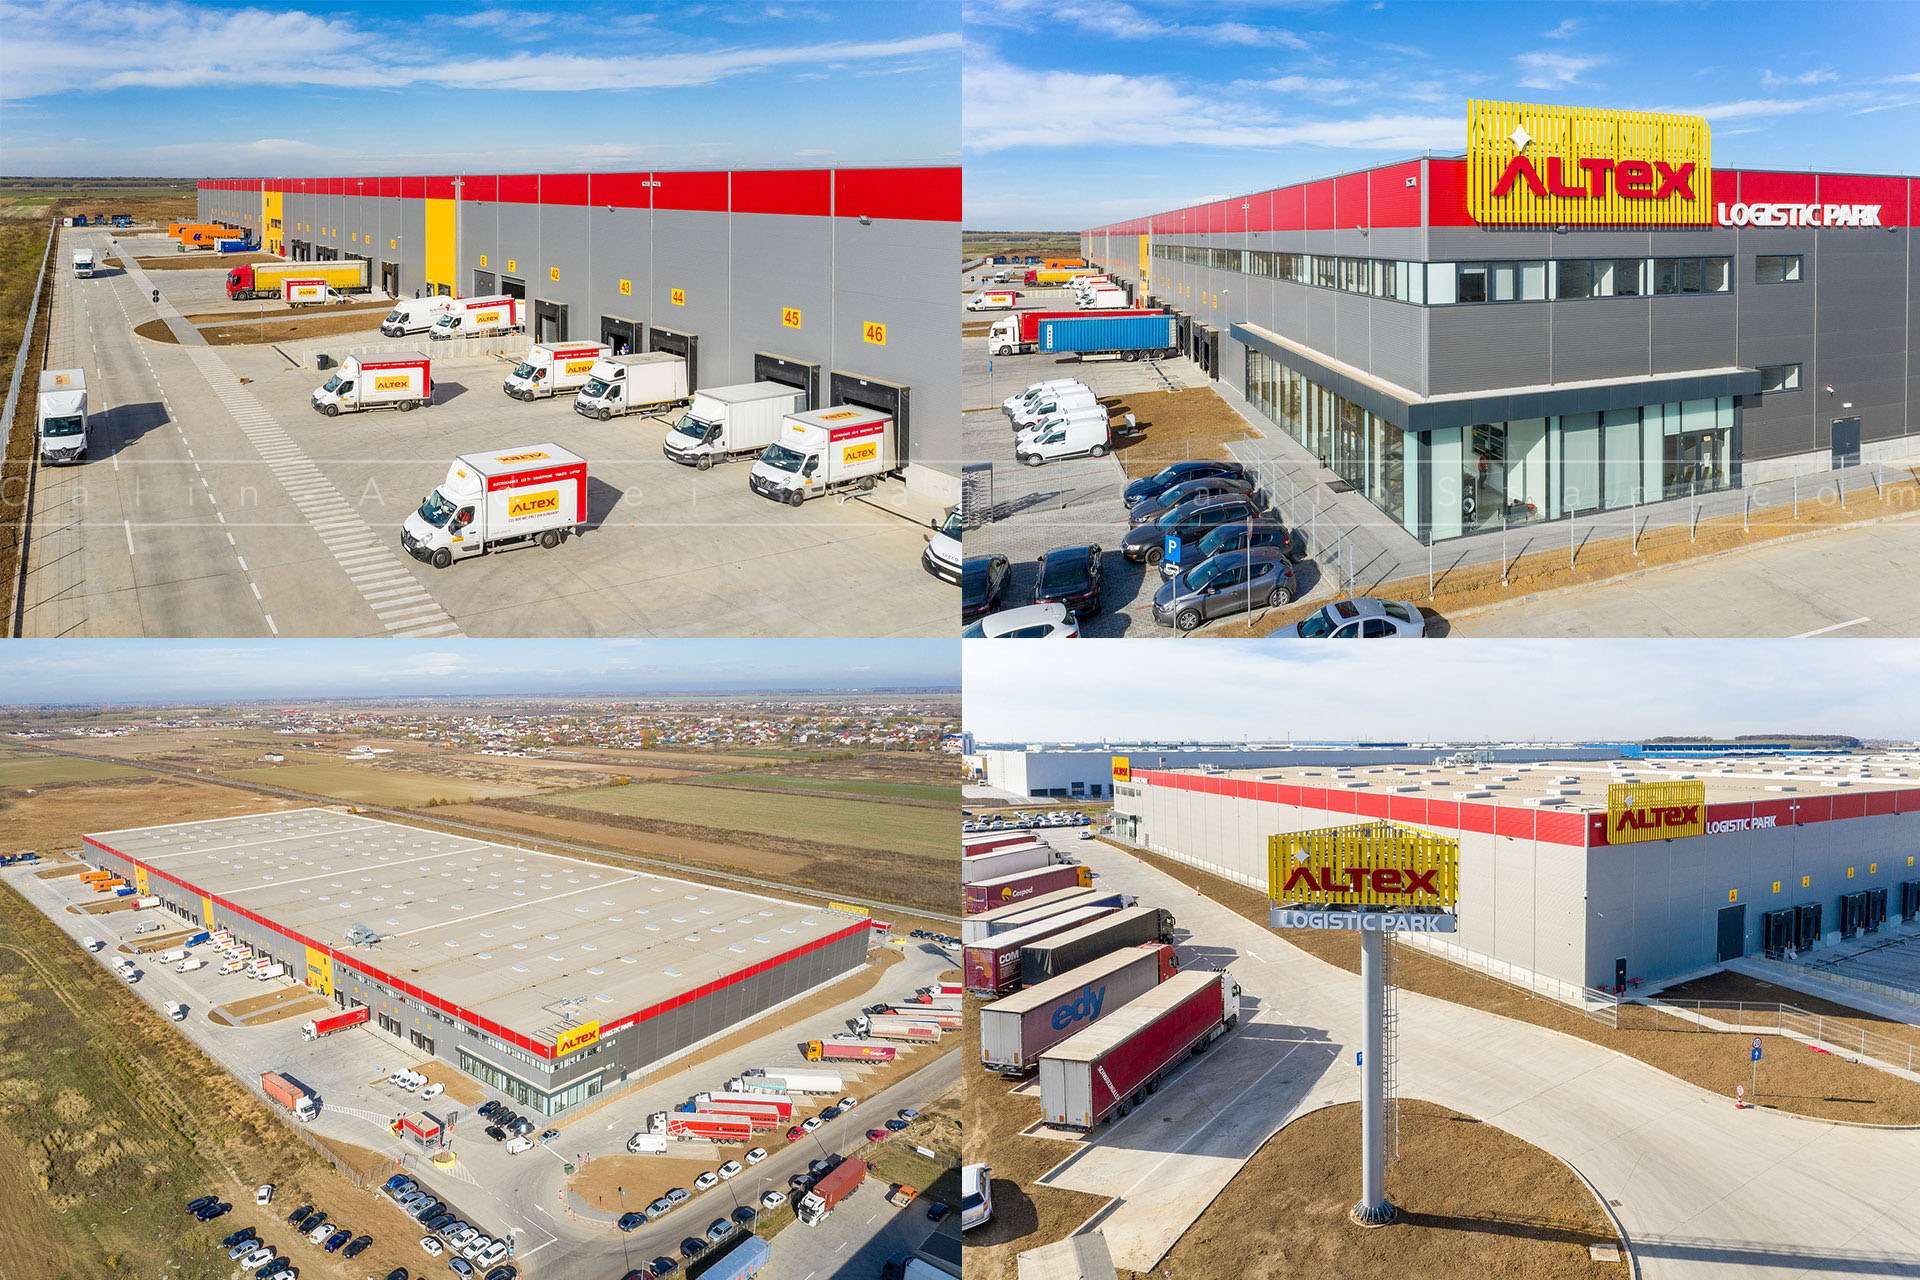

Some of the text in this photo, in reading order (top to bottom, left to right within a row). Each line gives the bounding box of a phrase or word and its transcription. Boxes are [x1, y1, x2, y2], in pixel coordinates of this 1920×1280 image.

[1717, 201, 1882, 227] LOGISTIC PARK
[551, 268, 559, 280] 42
[621, 281, 631, 294] 43
[672, 290, 685, 304] 44
[784, 310, 800, 327] 45
[866, 325, 884, 342] 46
[1168, 539, 1177, 554] P
[1706, 815, 1777, 835] LOGISTIC PARK
[1730, 891, 1736, 901] A
[1282, 912, 1440, 932] LOGISTIC PARK
[1052, 986, 1106, 1030] edy
